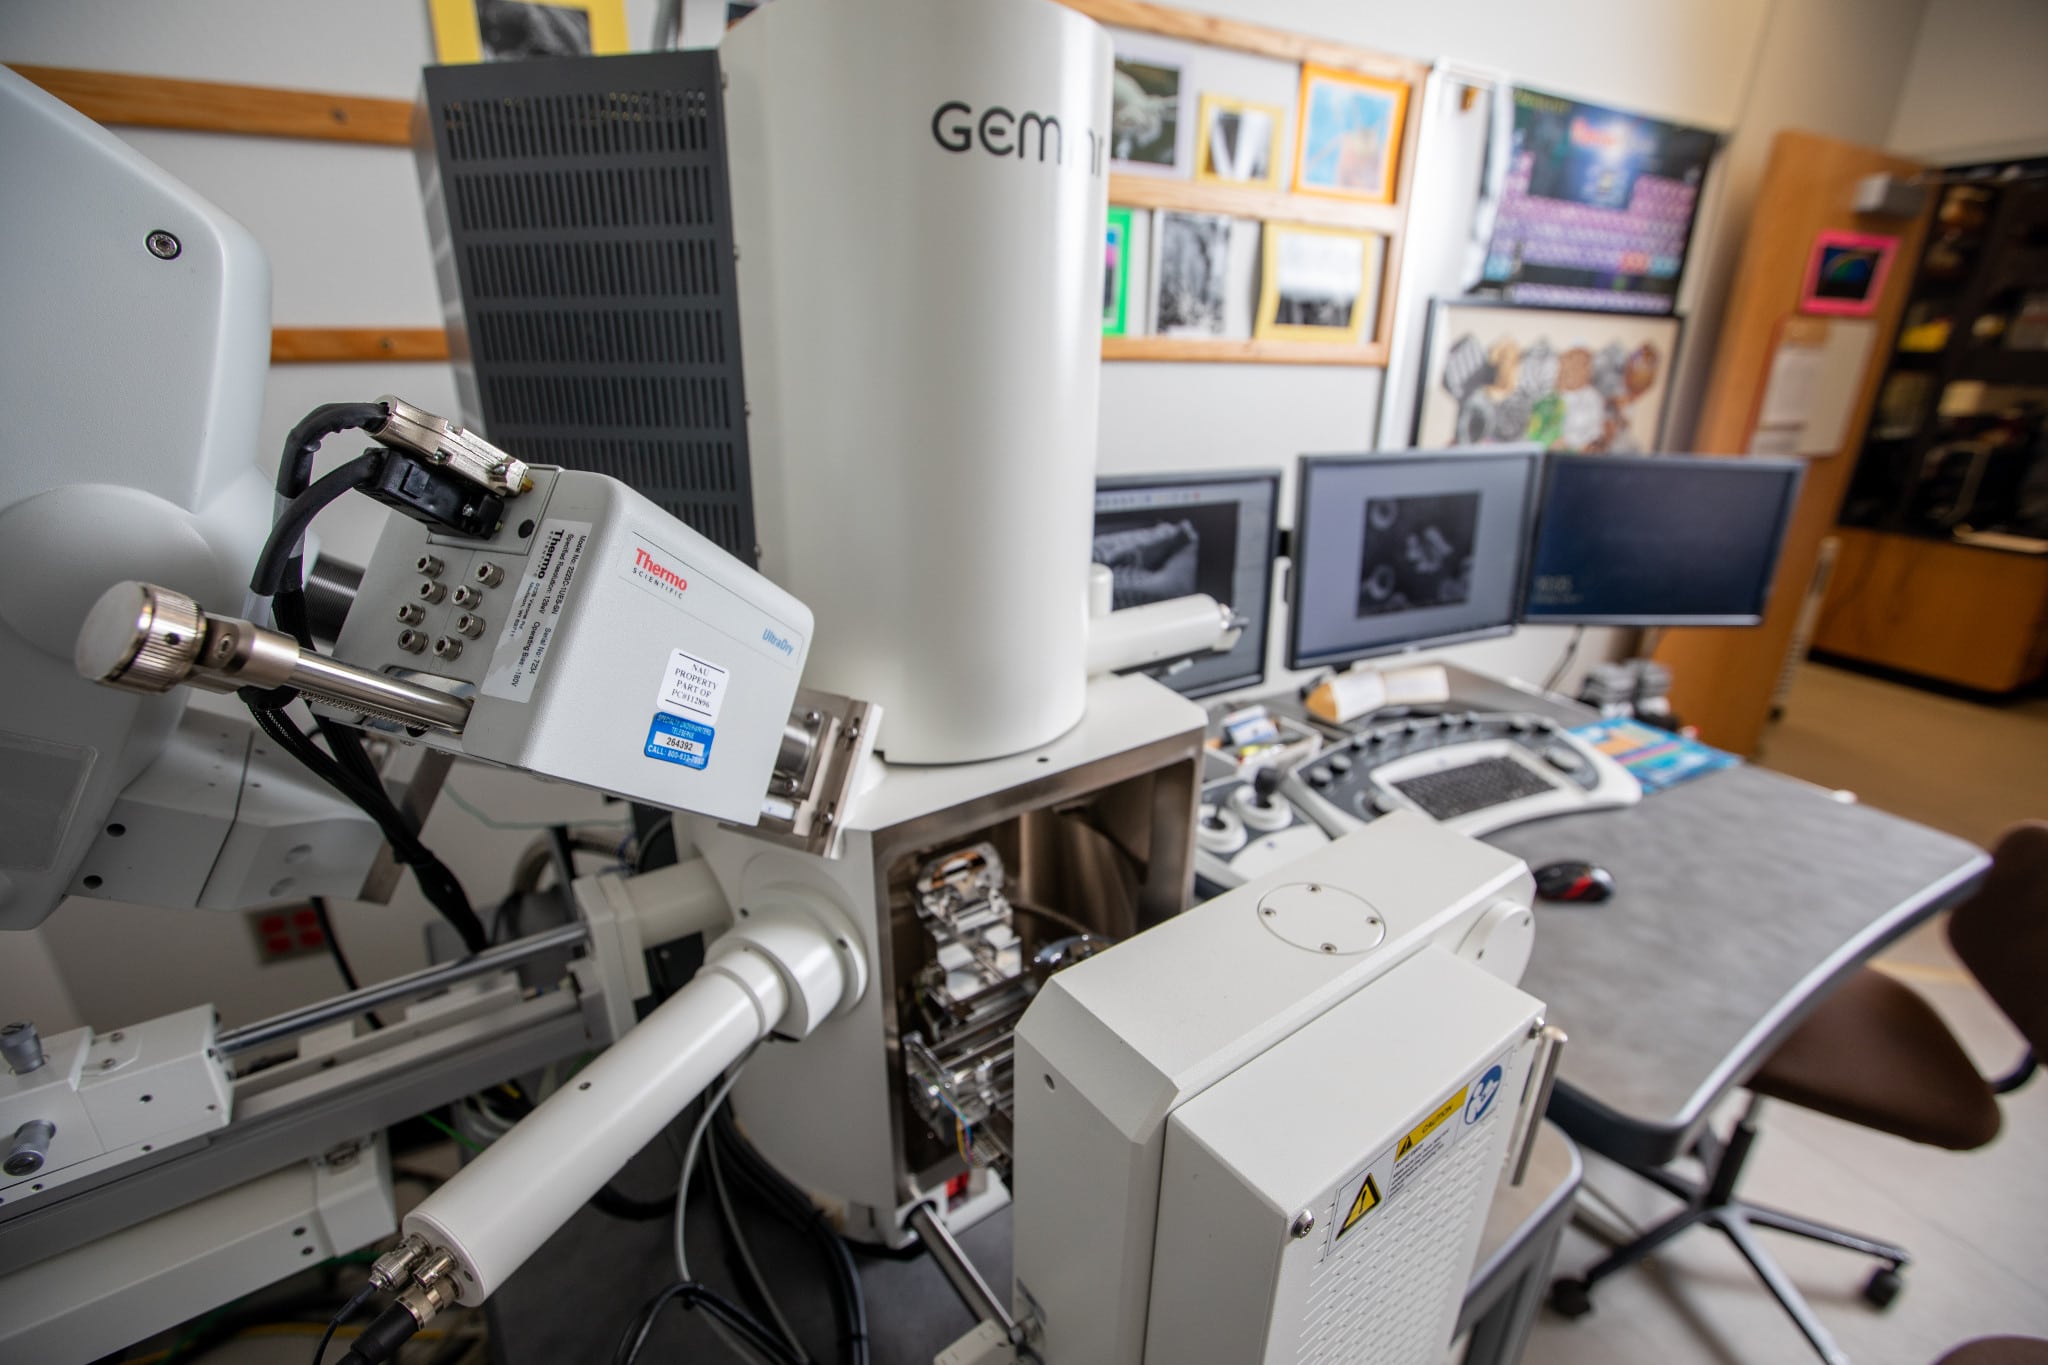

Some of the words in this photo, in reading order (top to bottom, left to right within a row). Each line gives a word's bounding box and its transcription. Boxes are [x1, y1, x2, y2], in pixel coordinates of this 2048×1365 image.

[537, 529, 565, 579] Thermo
[559, 534, 574, 560] Specified
[575, 535, 586, 553] Model
[547, 561, 564, 594] Resolution:
[635, 547, 688, 591] Thermo
[632, 567, 683, 600] SCIENTIFIC
[523, 621, 540, 651] Operating
[540, 627, 551, 646] Serial
[762, 628, 794, 656] UltraDry
[536, 646, 544, 658] No:
[674, 668, 718, 690] PROPERTY
[693, 664, 710, 676] NAU
[676, 680, 698, 694] PART
[700, 687, 712, 698] OF
[647, 745, 667, 756] CALL:
[666, 737, 694, 752] 264392
